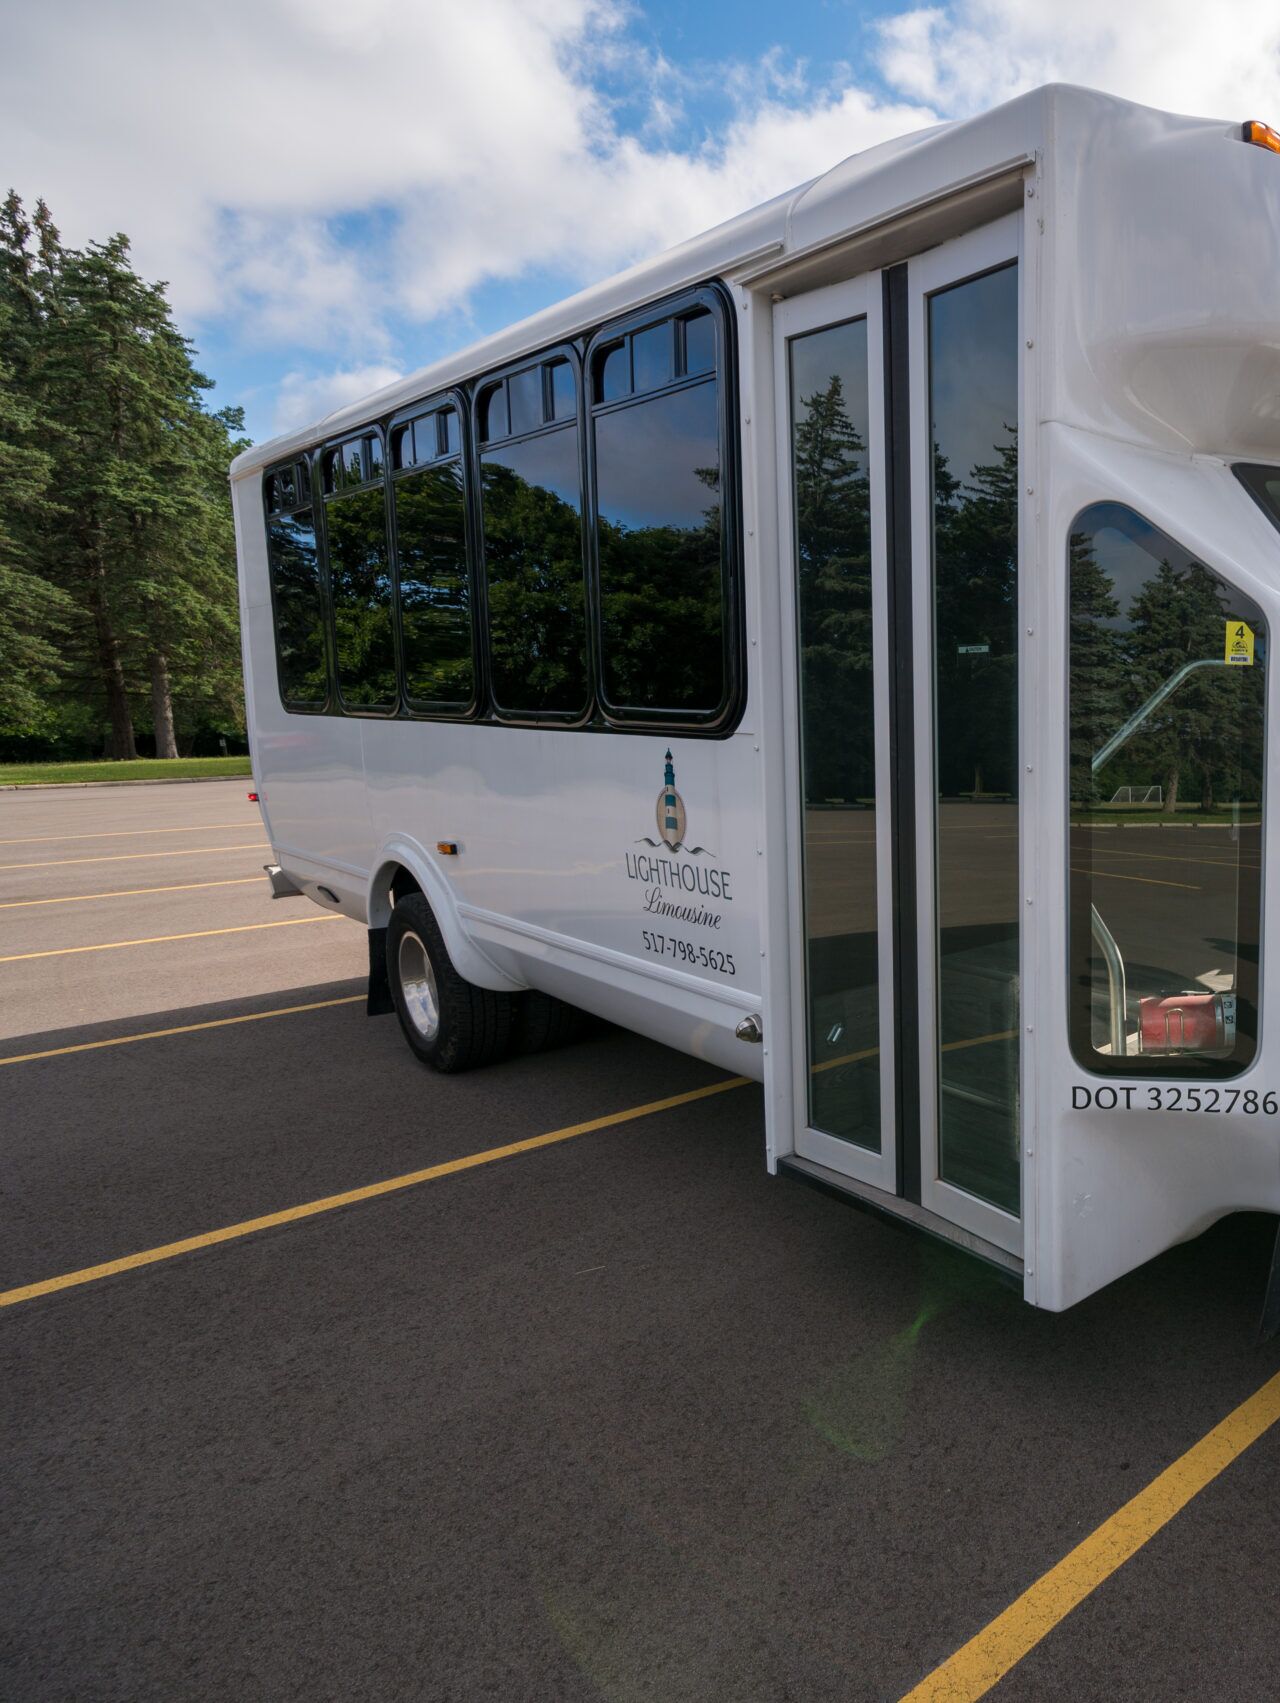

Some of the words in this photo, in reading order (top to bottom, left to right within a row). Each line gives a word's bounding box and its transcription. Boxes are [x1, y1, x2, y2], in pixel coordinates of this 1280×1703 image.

[1235, 625, 1245, 639] 4
[625, 852, 733, 901] LIGHTHOUSE
[642, 886, 721, 930] Limousine
[642, 930, 736, 976] 517-798-5625
[1071, 1086, 1137, 1111] DOT
[1147, 1087, 1279, 1115] 3252786
